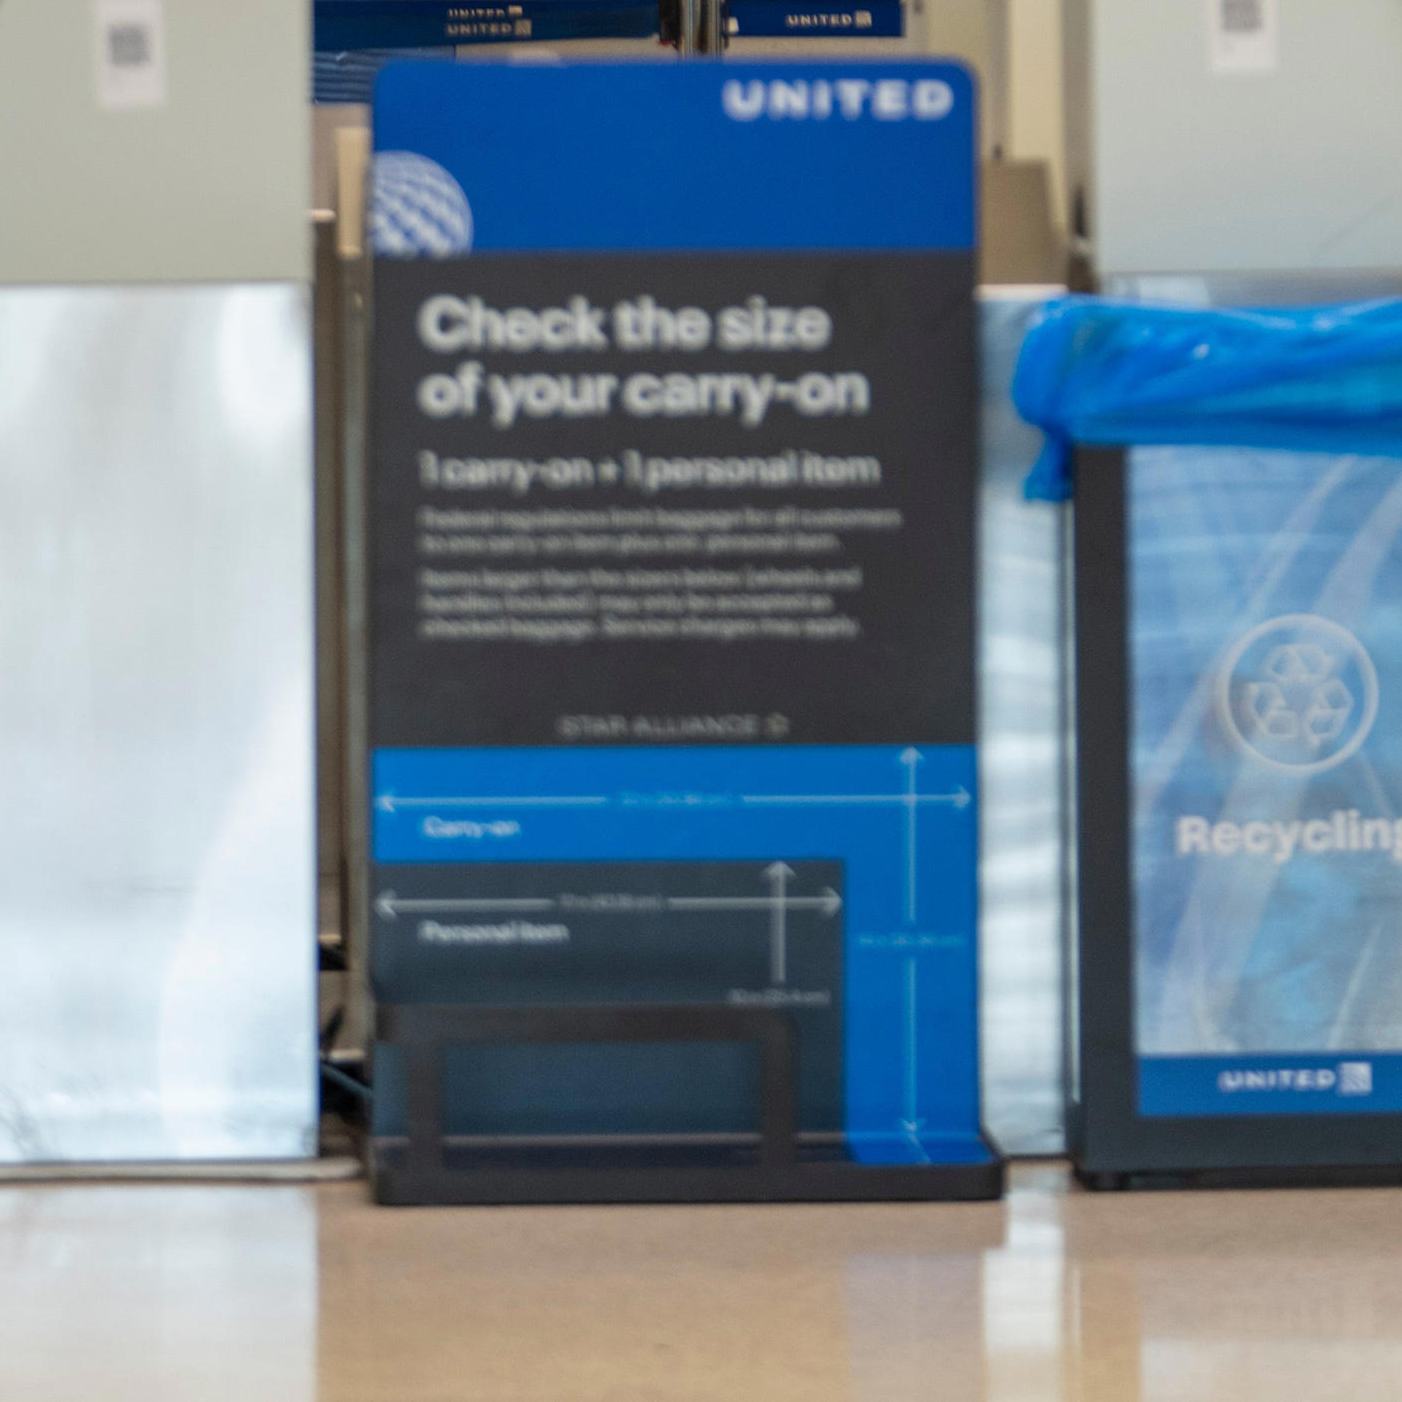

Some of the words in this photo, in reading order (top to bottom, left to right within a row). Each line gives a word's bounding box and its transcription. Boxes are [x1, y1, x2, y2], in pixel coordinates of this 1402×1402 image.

[446, 21, 512, 36] UNITED
[786, 13, 853, 27] UNITED
[722, 79, 954, 121] UNITED
[417, 295, 607, 353] Check
[611, 295, 712, 351] the
[715, 295, 833, 352] size
[417, 360, 484, 418] of
[487, 372, 618, 429] your
[622, 372, 870, 429] carry-on
[439, 456, 594, 496] carry-on
[644, 449, 799, 496] personal
[1219, 1067, 1337, 1091] UNITED
